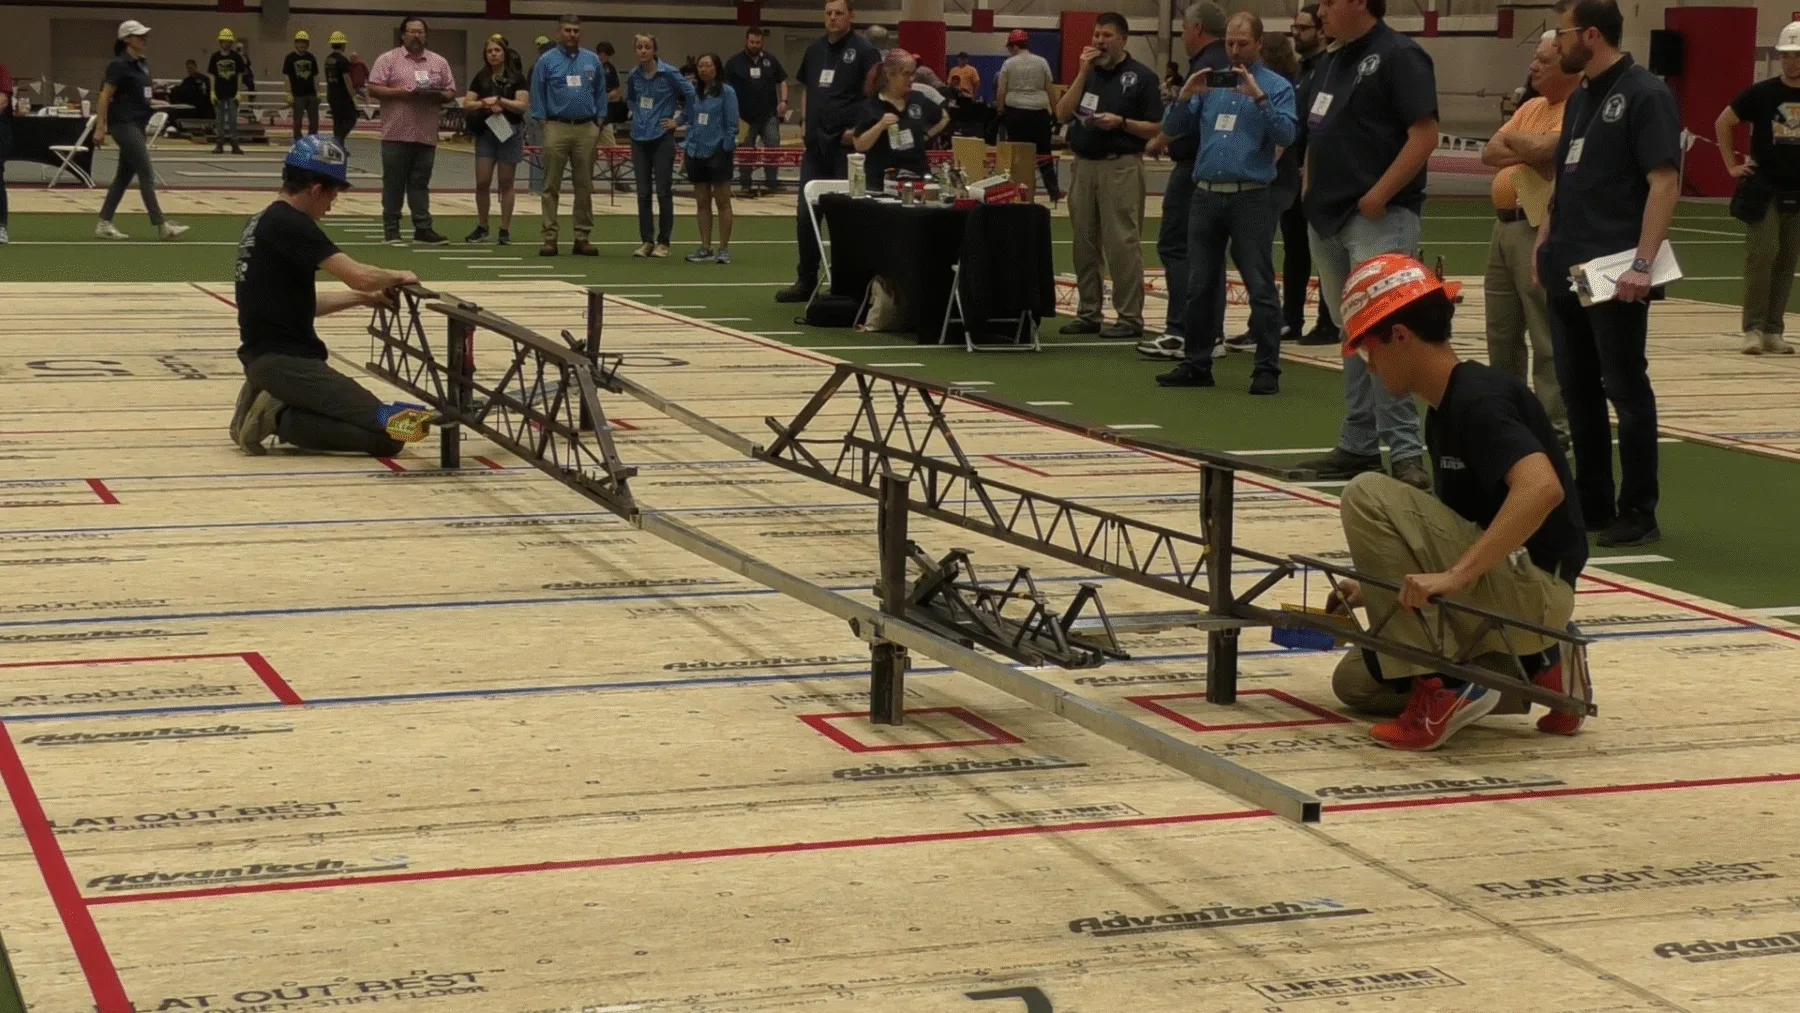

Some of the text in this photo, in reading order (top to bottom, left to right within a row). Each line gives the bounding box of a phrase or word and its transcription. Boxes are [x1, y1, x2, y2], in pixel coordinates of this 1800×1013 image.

[663, 656, 838, 670] AdvanTech
[21, 725, 241, 744] AdvanTech
[1201, 741, 1260, 752] LAT
[833, 758, 1034, 779] AdvanTech
[1315, 775, 1510, 797] AdvanTech
[48, 816, 122, 828] LAT
[87, 859, 344, 888] AdvanTech
[1476, 877, 1570, 893] FLAT
[1577, 871, 1658, 885] OUT
[1068, 901, 1304, 934] AdvanTech
[1262, 969, 1437, 994] LIFETIME
[233, 984, 339, 1003] OUT
